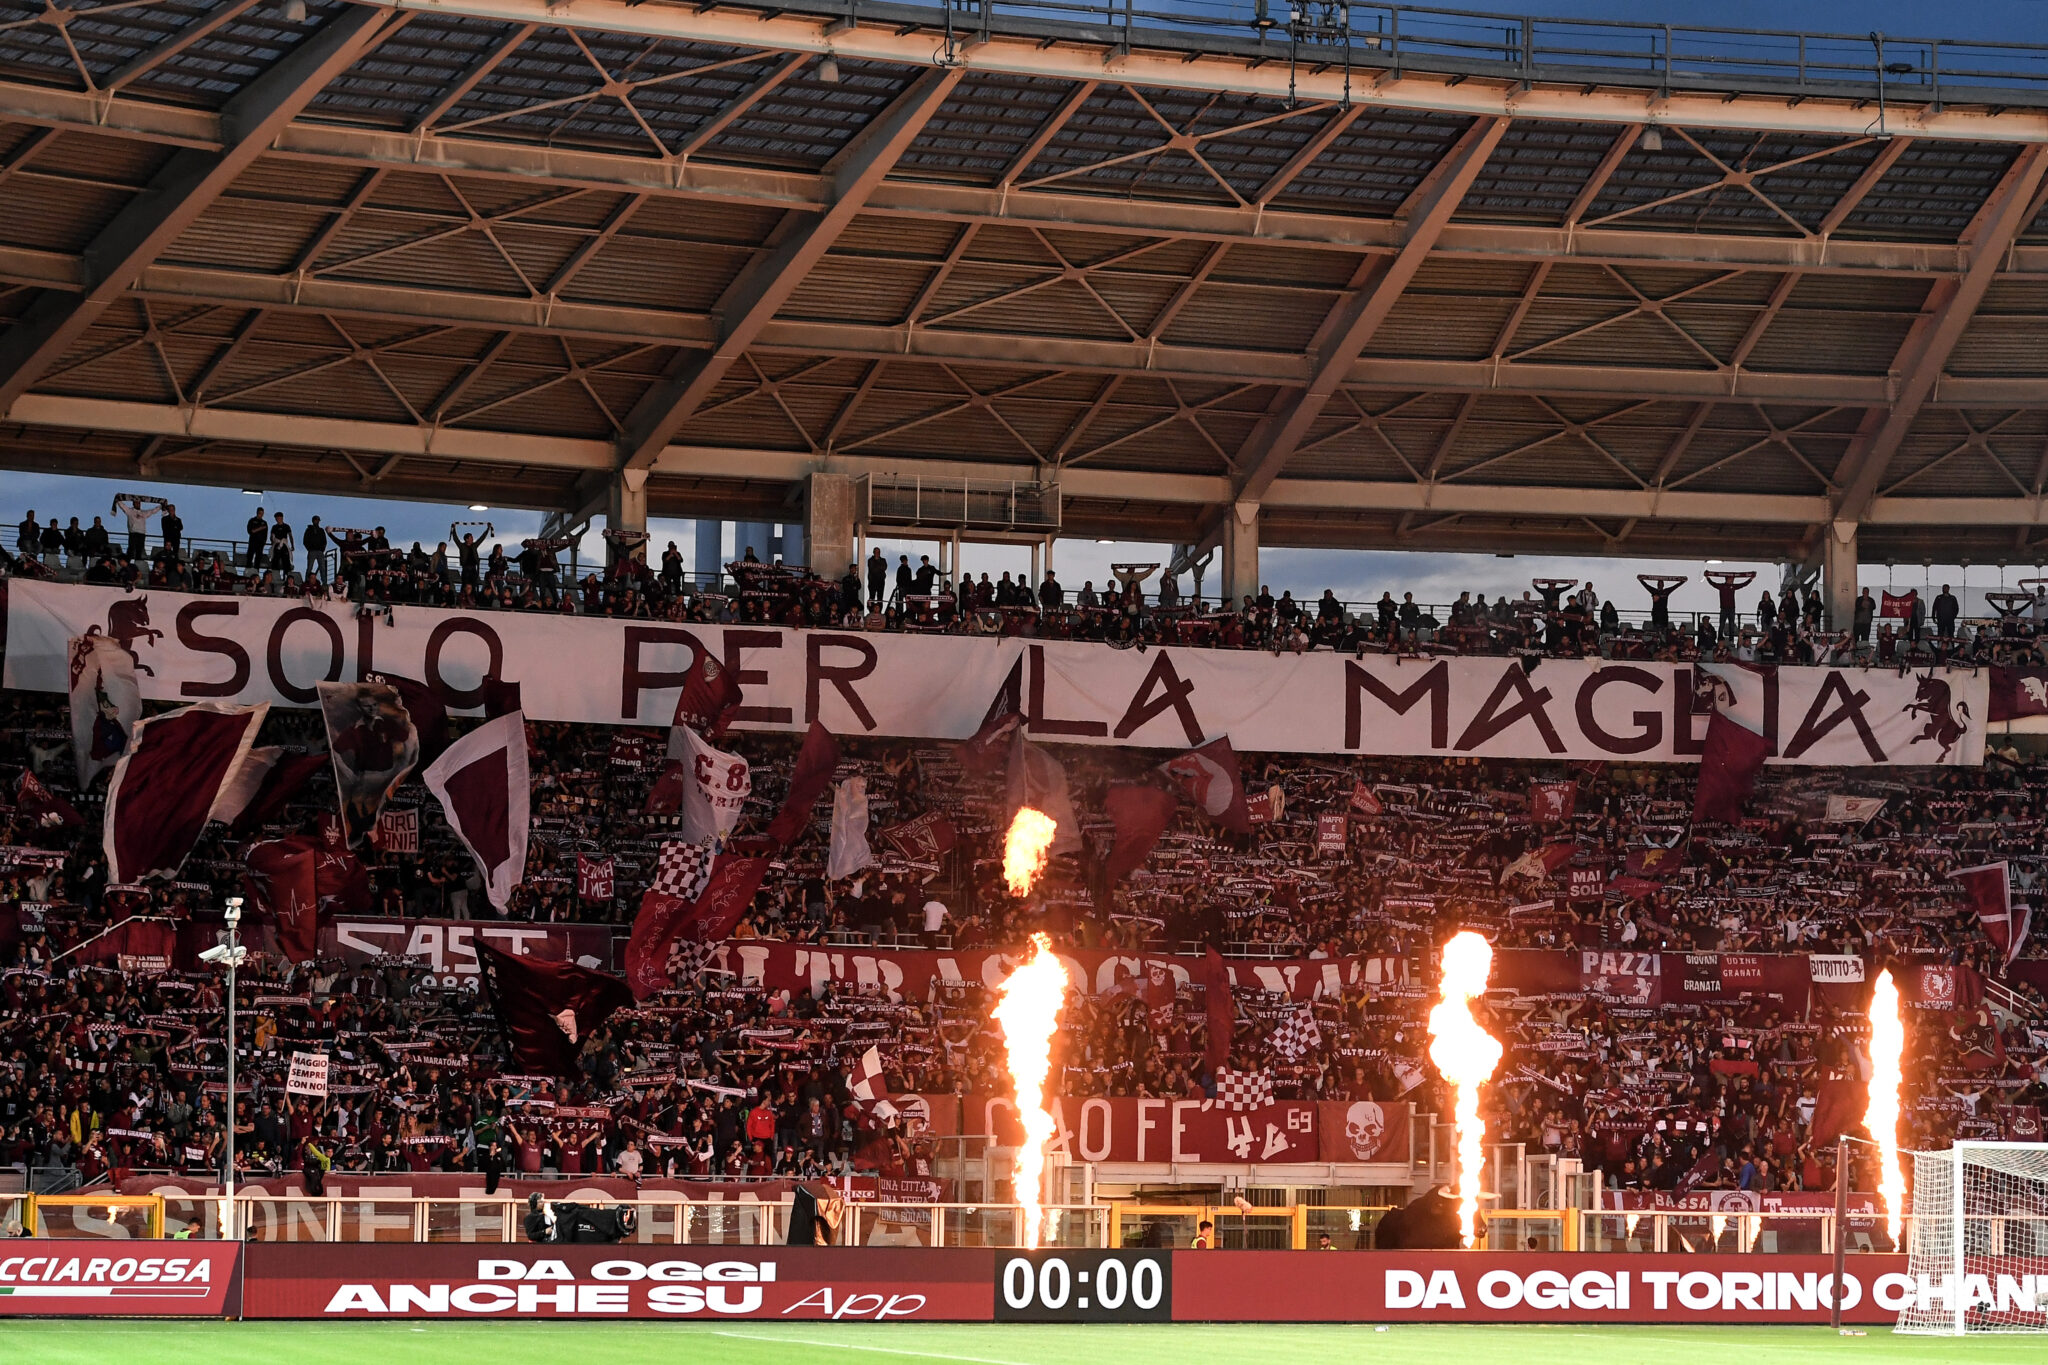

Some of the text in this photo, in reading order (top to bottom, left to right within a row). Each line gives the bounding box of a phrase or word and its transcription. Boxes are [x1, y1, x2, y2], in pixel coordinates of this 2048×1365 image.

[176, 600, 1888, 762] SOLO PER LA MAGLIA
[1321, 815, 1344, 824] MAFFO
[1321, 832, 1343, 840] ZOPPO
[177, 881, 210, 892] TORINO
[1582, 951, 1661, 976] PAZZI
[1685, 955, 1718, 965] GIOVANI
[1726, 957, 1758, 965] UDINE
[1722, 969, 1762, 978] GRANATA
[1810, 959, 1850, 977] BITRITTO
[1683, 979, 1721, 992] GRANATA
[292, 1056, 328, 1068] MAGGIO
[423, 1055, 462, 1068] MARATONA
[290, 1068, 327, 1080] SEMPRE
[287, 1079, 327, 1092] CON NOI
[1287, 1108, 1313, 1134] 69
[409, 1136, 445, 1145] GRANATA
[880, 1179, 899, 1192] UNA
[1850, 1220, 1871, 1228] GROUP
[0, 1257, 211, 1283] CCIAROSSA
[477, 1260, 777, 1283] DA OGGI
[1003, 1257, 1163, 1310] 00:00
[1385, 1270, 1467, 1309] DA
[1476, 1270, 1630, 1310] OGGI
[1641, 1271, 1863, 1312] TORINO
[323, 1284, 927, 1320] ANCHE SU App
